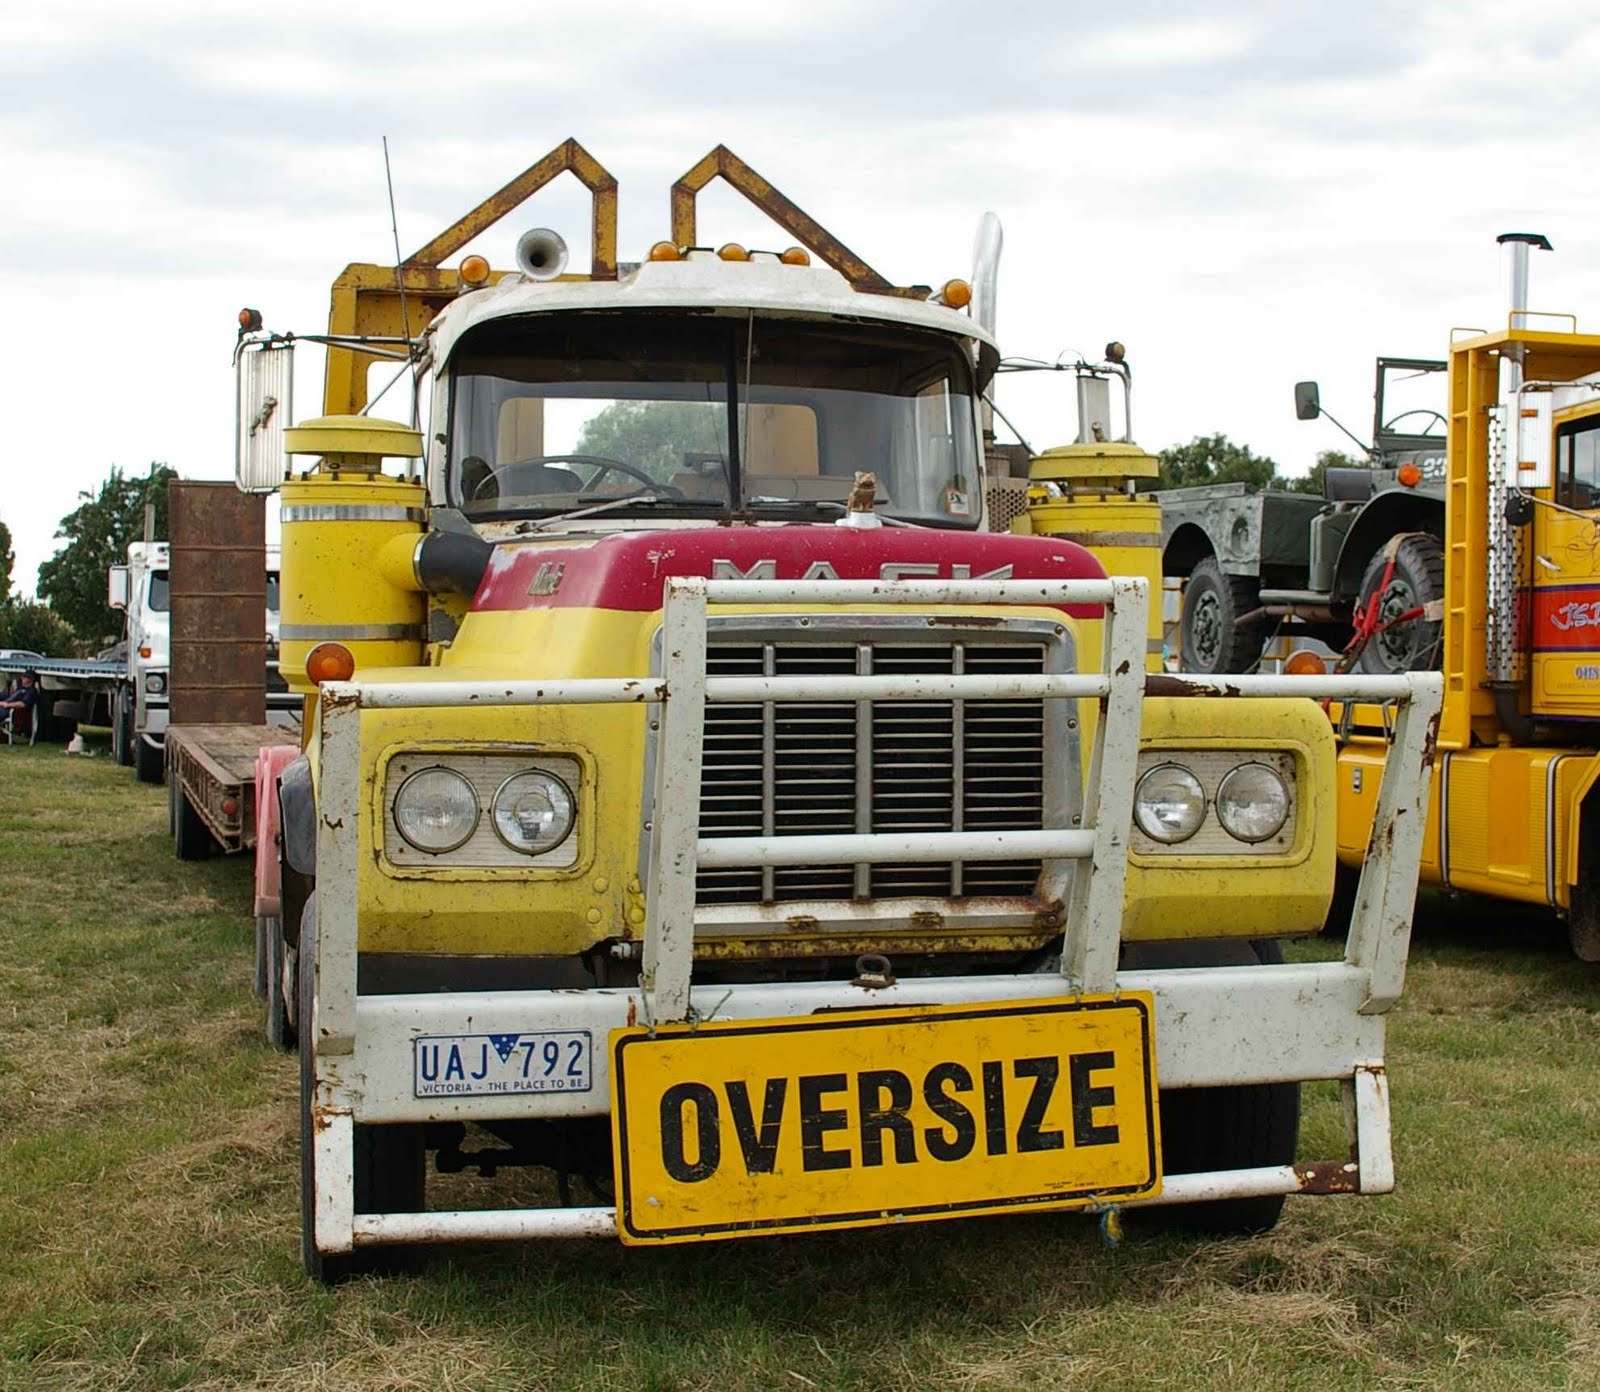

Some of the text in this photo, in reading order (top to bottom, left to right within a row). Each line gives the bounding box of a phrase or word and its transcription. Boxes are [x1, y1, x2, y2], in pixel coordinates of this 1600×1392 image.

[421, 1039, 584, 1081] UAJ 792
[422, 1083, 473, 1094] VICTORIA
[488, 1081, 508, 1091] THE
[513, 1080, 546, 1090] PLACE
[551, 1079, 565, 1089] TO
[570, 1078, 583, 1088] BE
[659, 1051, 1121, 1184] OVERSIZE
